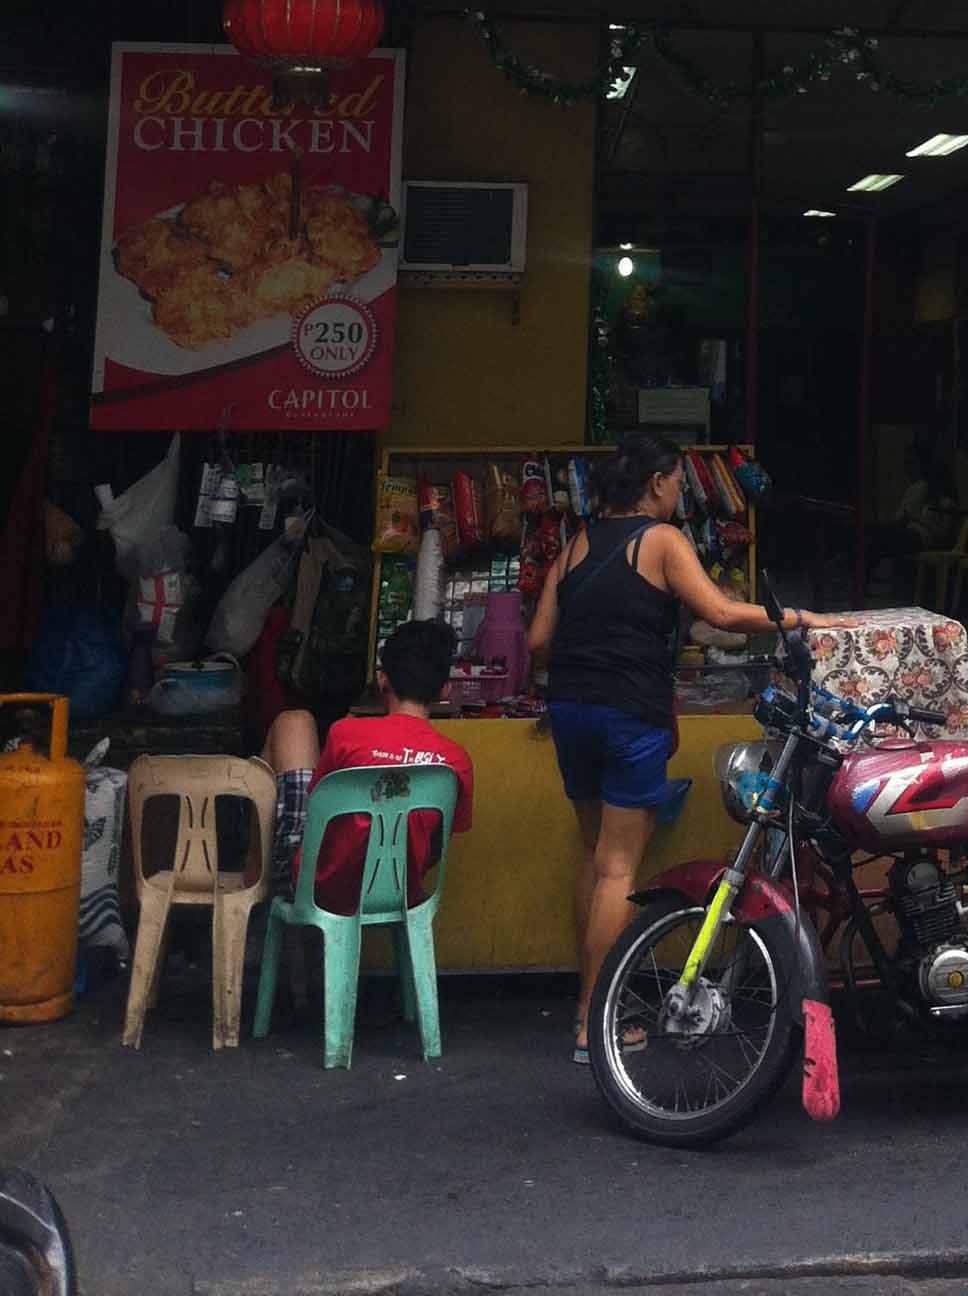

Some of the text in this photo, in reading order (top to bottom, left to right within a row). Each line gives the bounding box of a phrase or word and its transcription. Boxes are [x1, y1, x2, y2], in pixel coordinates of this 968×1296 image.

[132, 115, 377, 153] CHICKEN
[310, 345, 358, 361] ONLY
[267, 388, 374, 410] CAPITOL
[0, 830, 63, 850] AND
